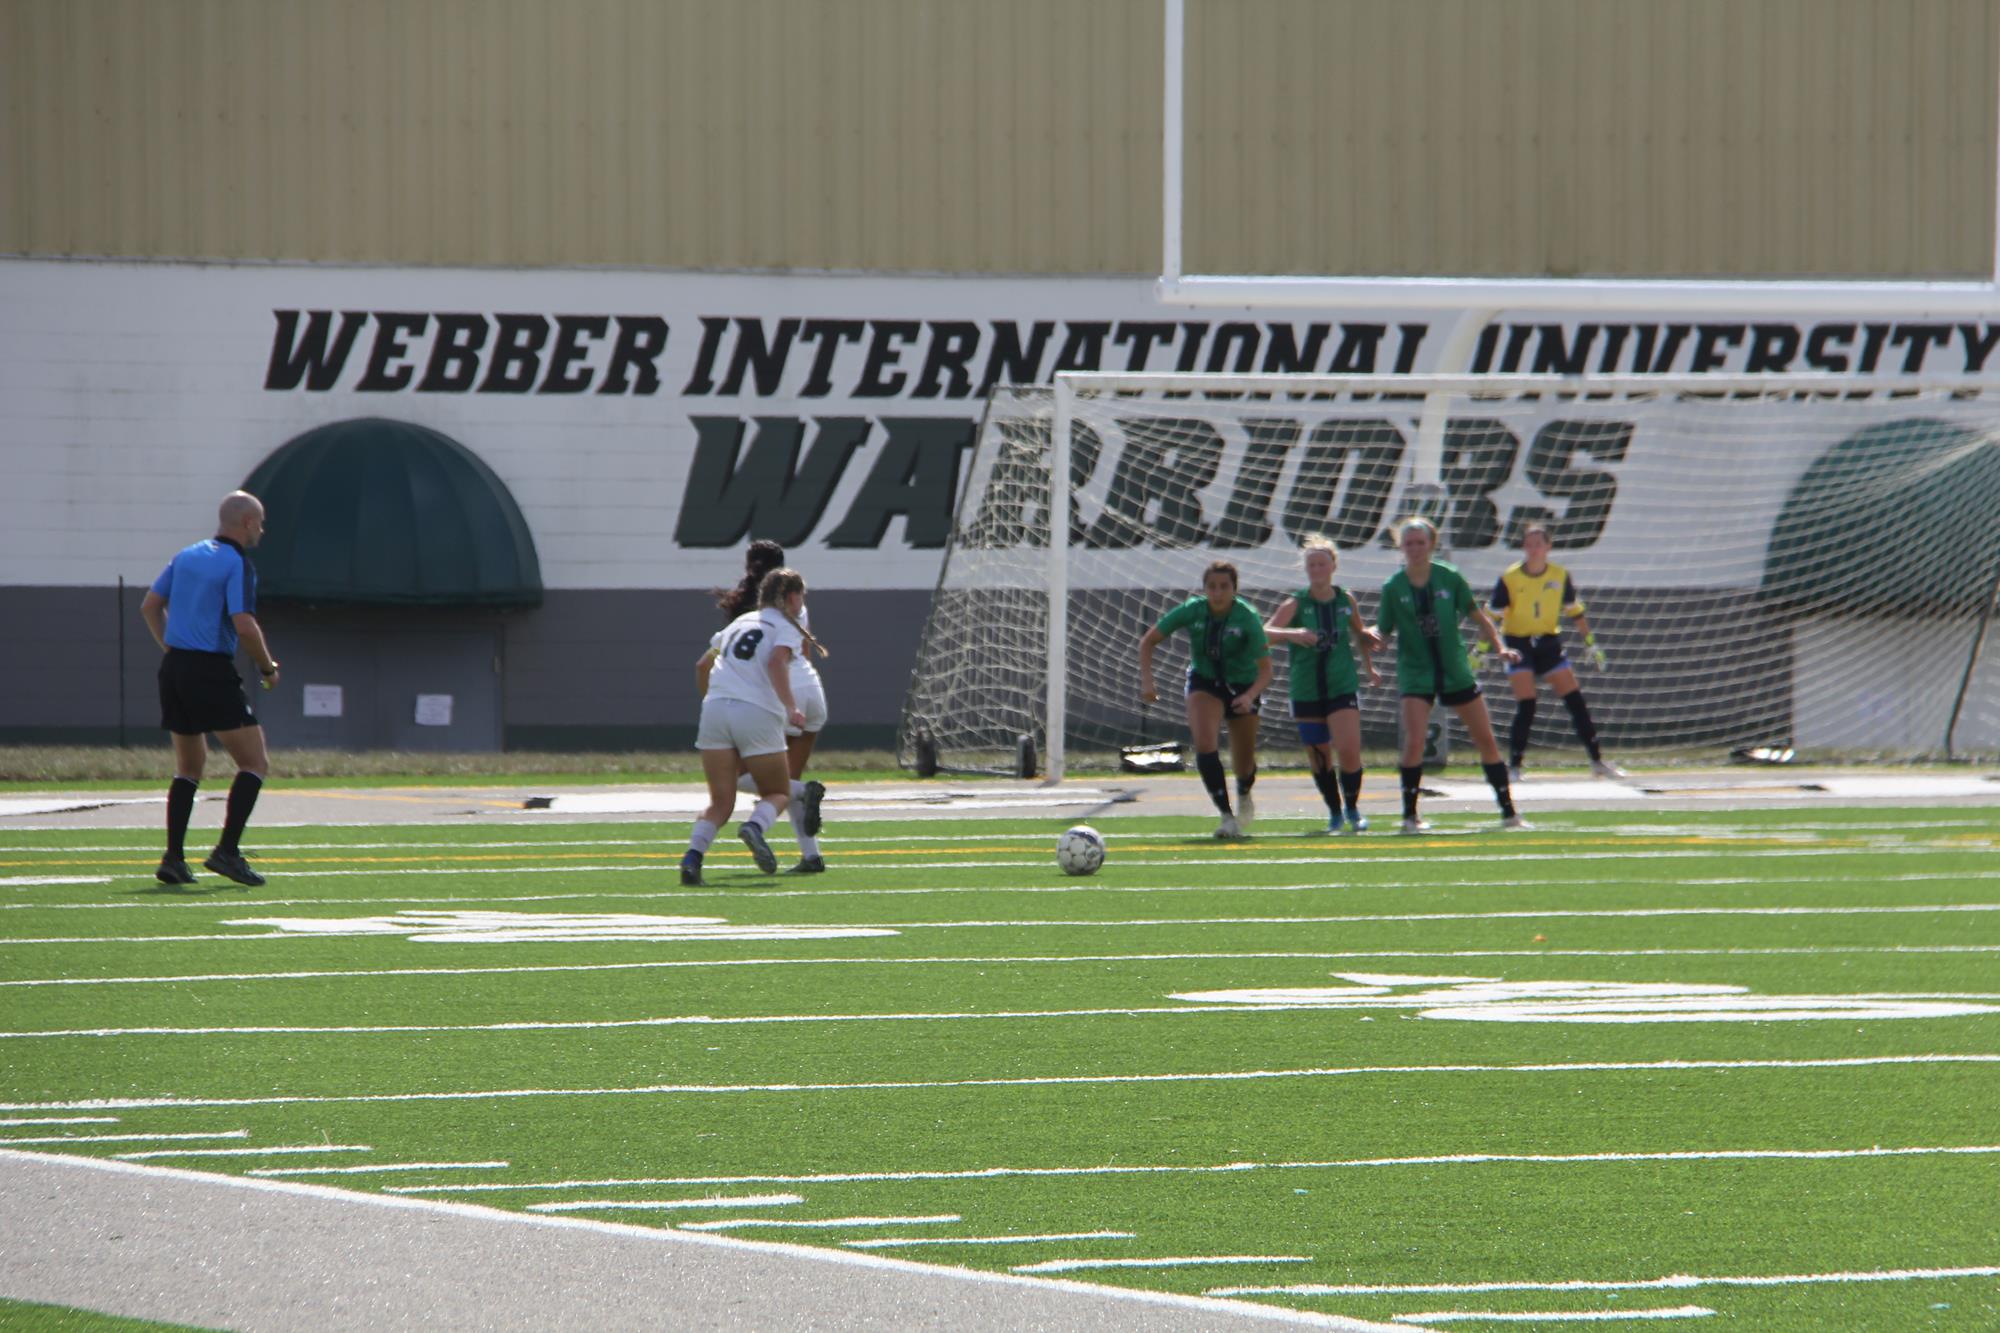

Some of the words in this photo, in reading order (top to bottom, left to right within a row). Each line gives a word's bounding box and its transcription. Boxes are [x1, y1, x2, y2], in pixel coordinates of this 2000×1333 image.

[264, 309, 670, 396] WEBBER
[681, 316, 1430, 401] INTERNATIONAL
[1470, 323, 2000, 401] UNIVERSITY
[672, 414, 1636, 550] WARRIORS
